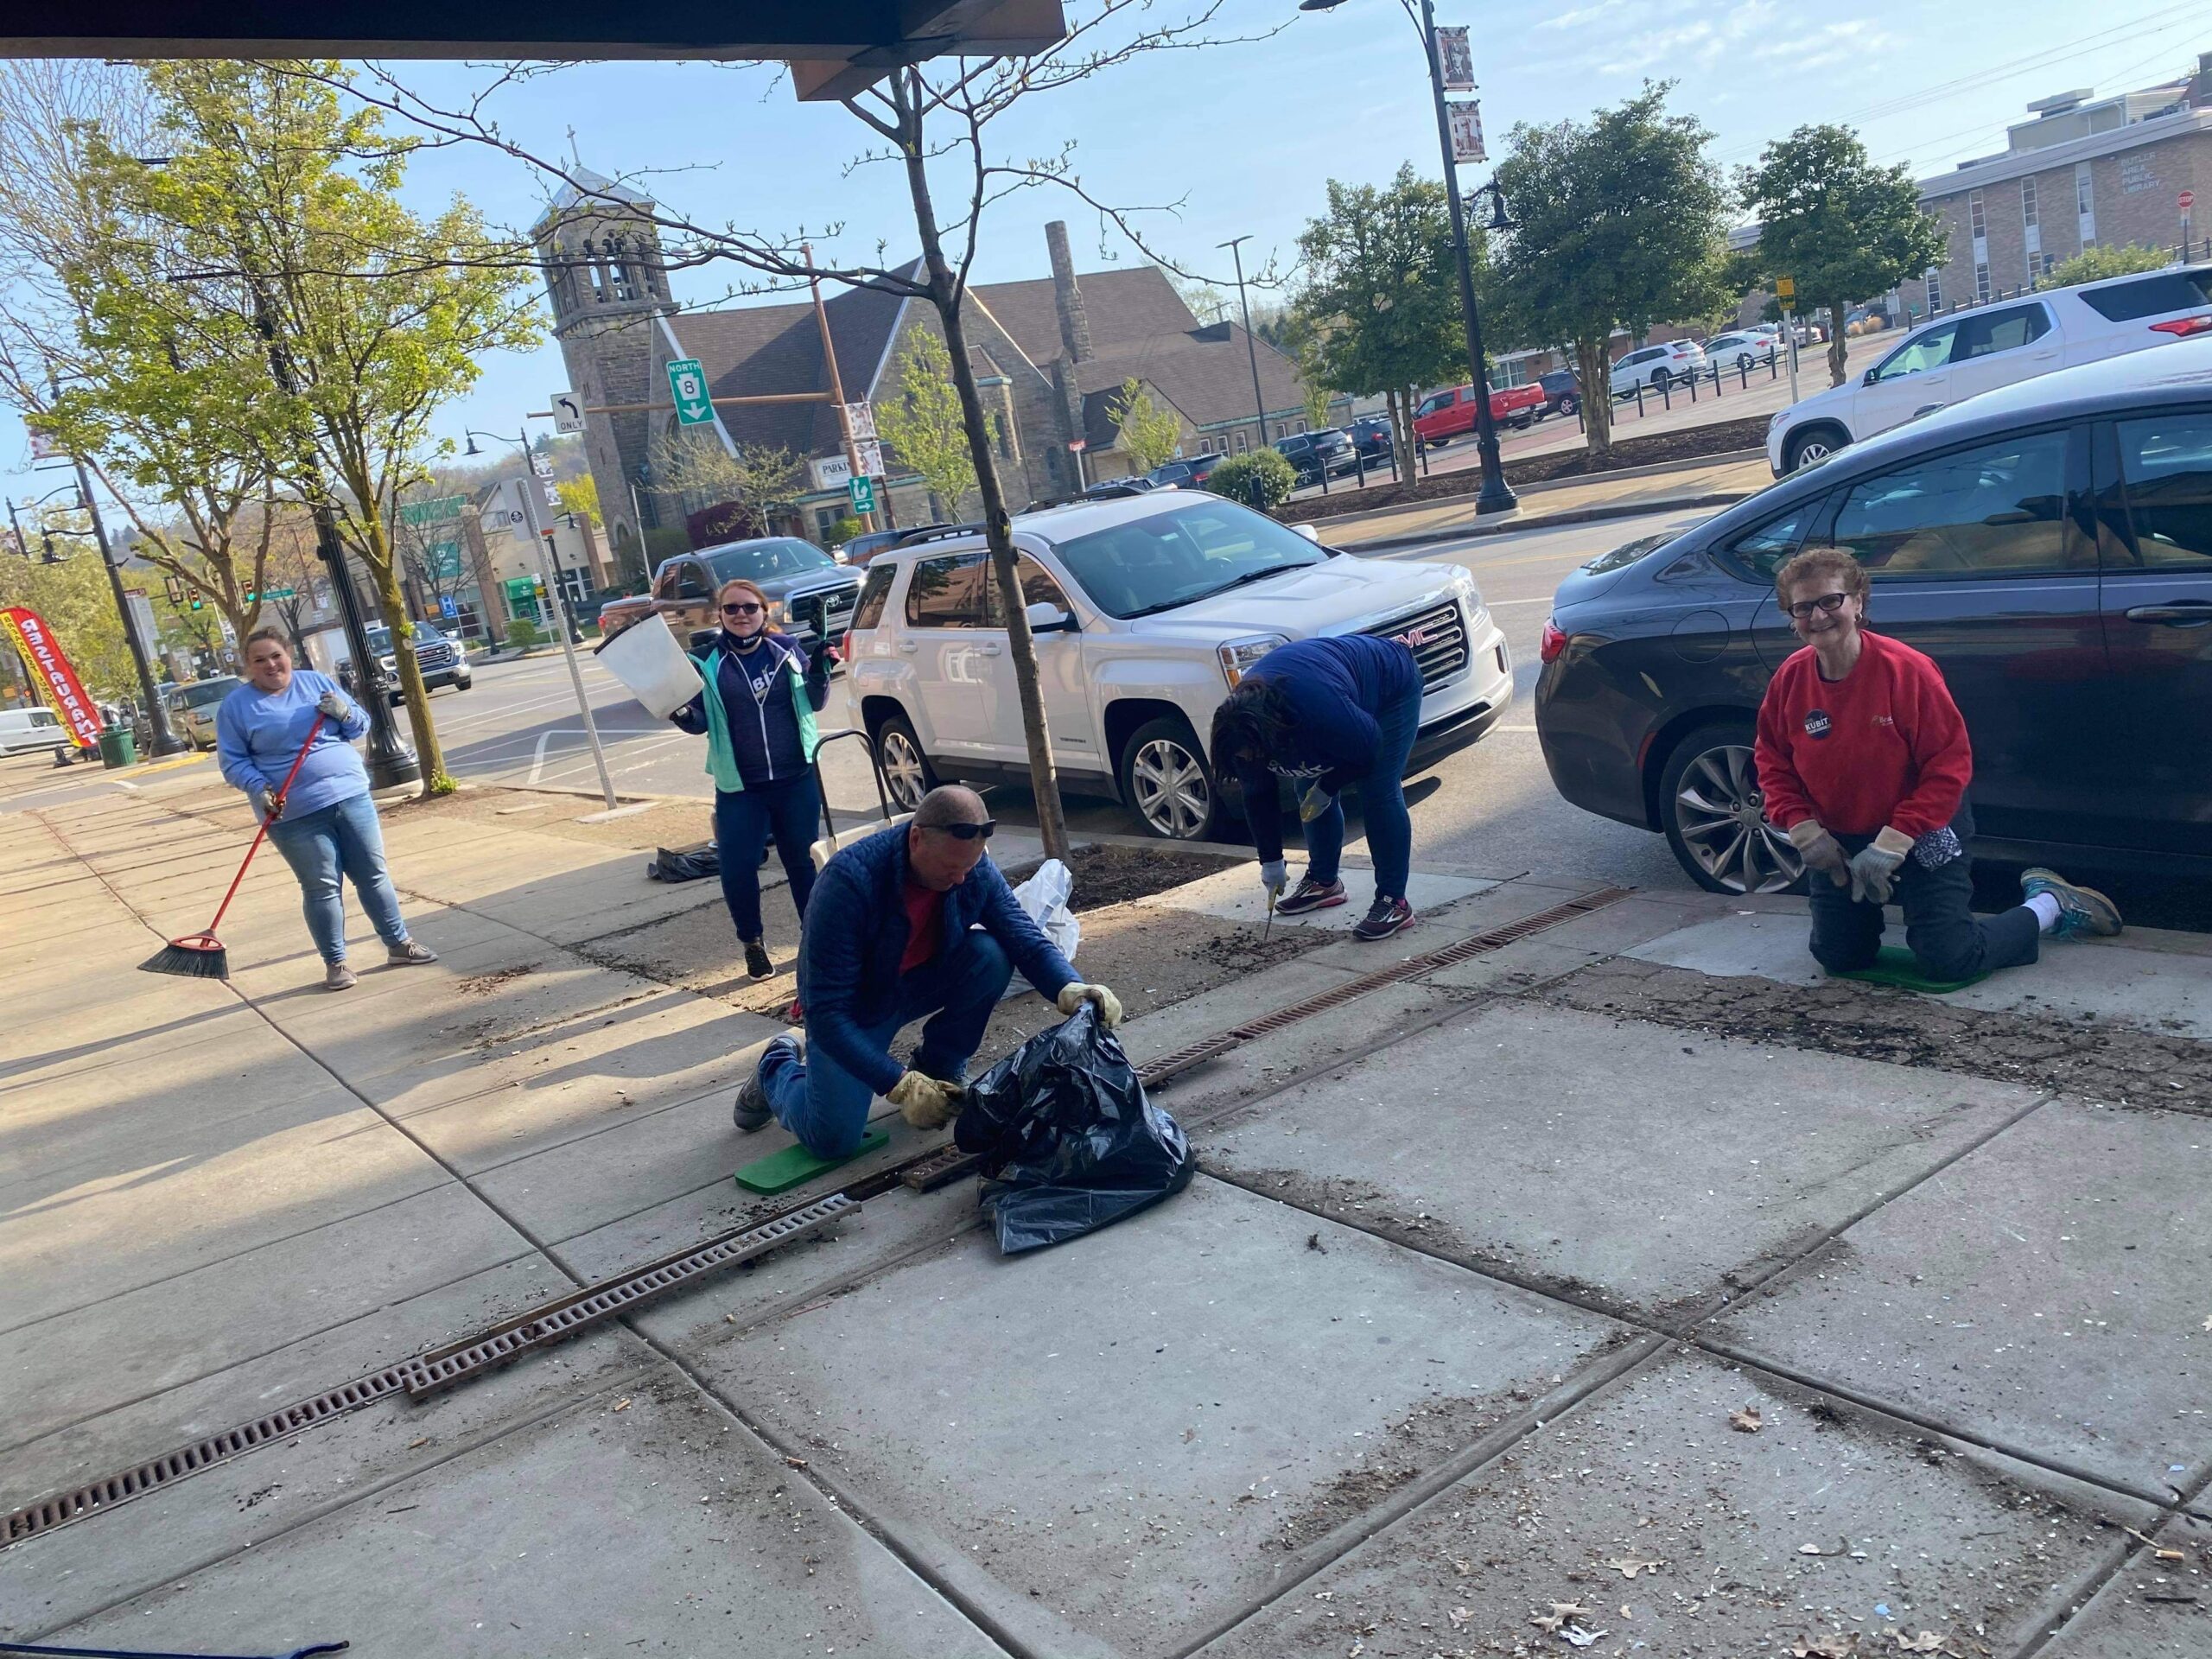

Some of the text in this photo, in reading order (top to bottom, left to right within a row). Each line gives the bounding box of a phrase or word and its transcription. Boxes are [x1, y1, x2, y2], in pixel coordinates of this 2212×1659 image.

[2121, 152, 2156, 167] BUTLER
[2122, 164, 2145, 175] AREA
[2122, 172, 2156, 186] PUBLIC
[2123, 179, 2160, 194] LIBRARY
[2178, 194, 2194, 204] STOP
[669, 362, 701, 373] NORTH
[683, 380, 695, 395] 8
[561, 420, 583, 430] ONLY
[823, 461, 851, 474] PARKI
[441, 596, 454, 610] H
[1389, 622, 1439, 649] MC
[1805, 717, 1828, 731] KUBIT
